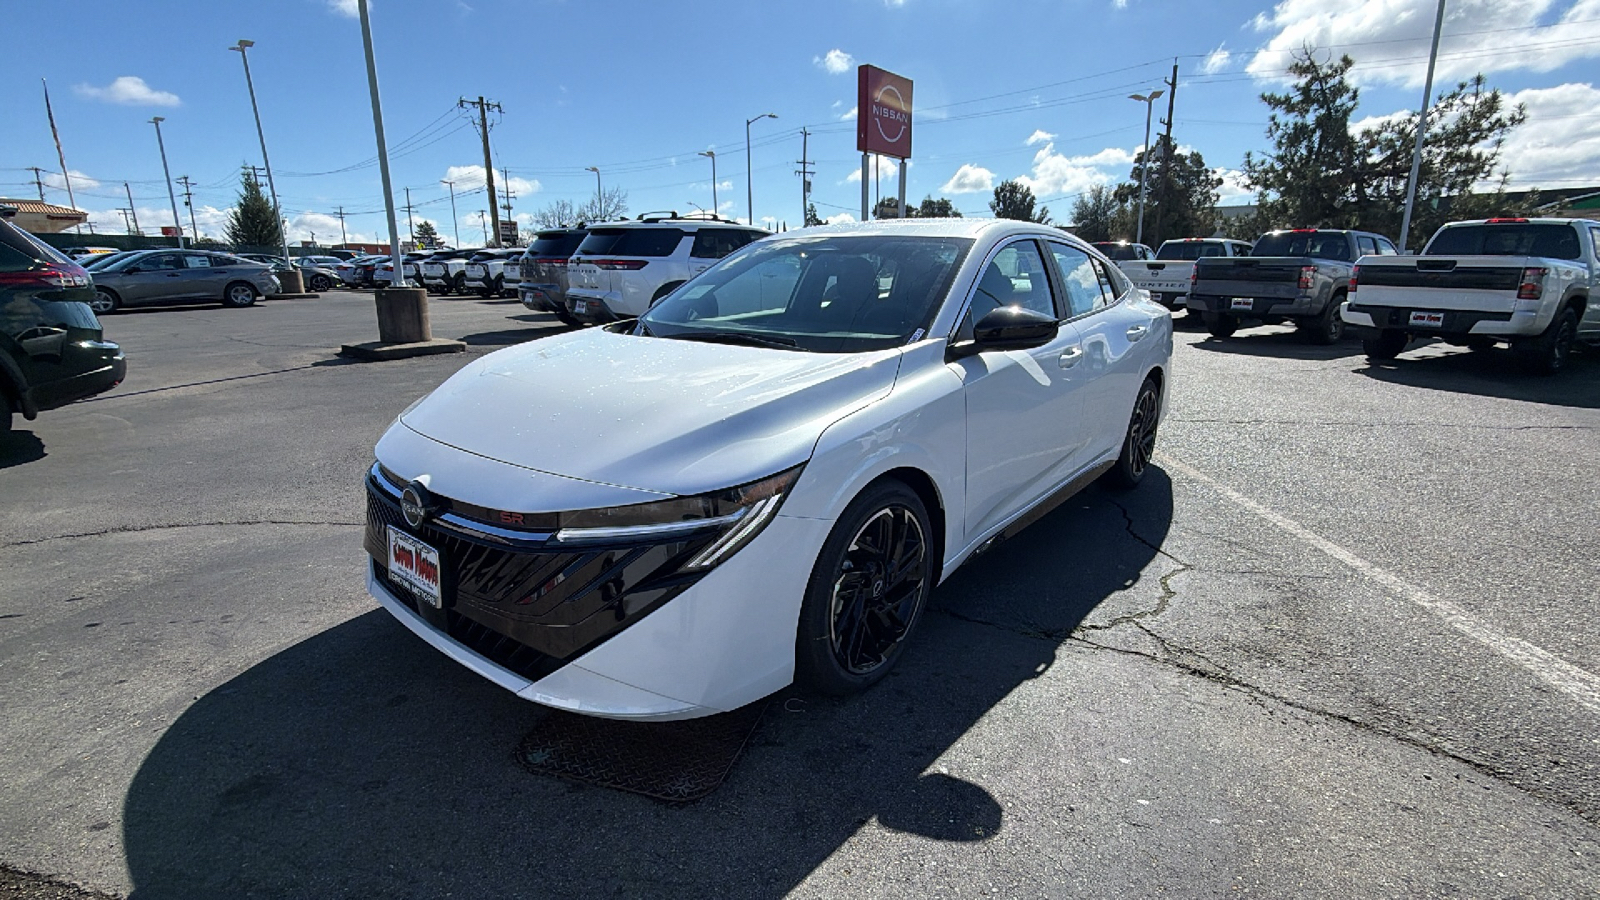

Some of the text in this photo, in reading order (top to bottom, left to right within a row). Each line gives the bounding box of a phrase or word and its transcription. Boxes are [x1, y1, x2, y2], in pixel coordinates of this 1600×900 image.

[873, 104, 908, 123] NISSAN
[500, 511, 525, 525] SR
[391, 573, 411, 590] CROWN
[412, 586, 436, 606] MOTORS
